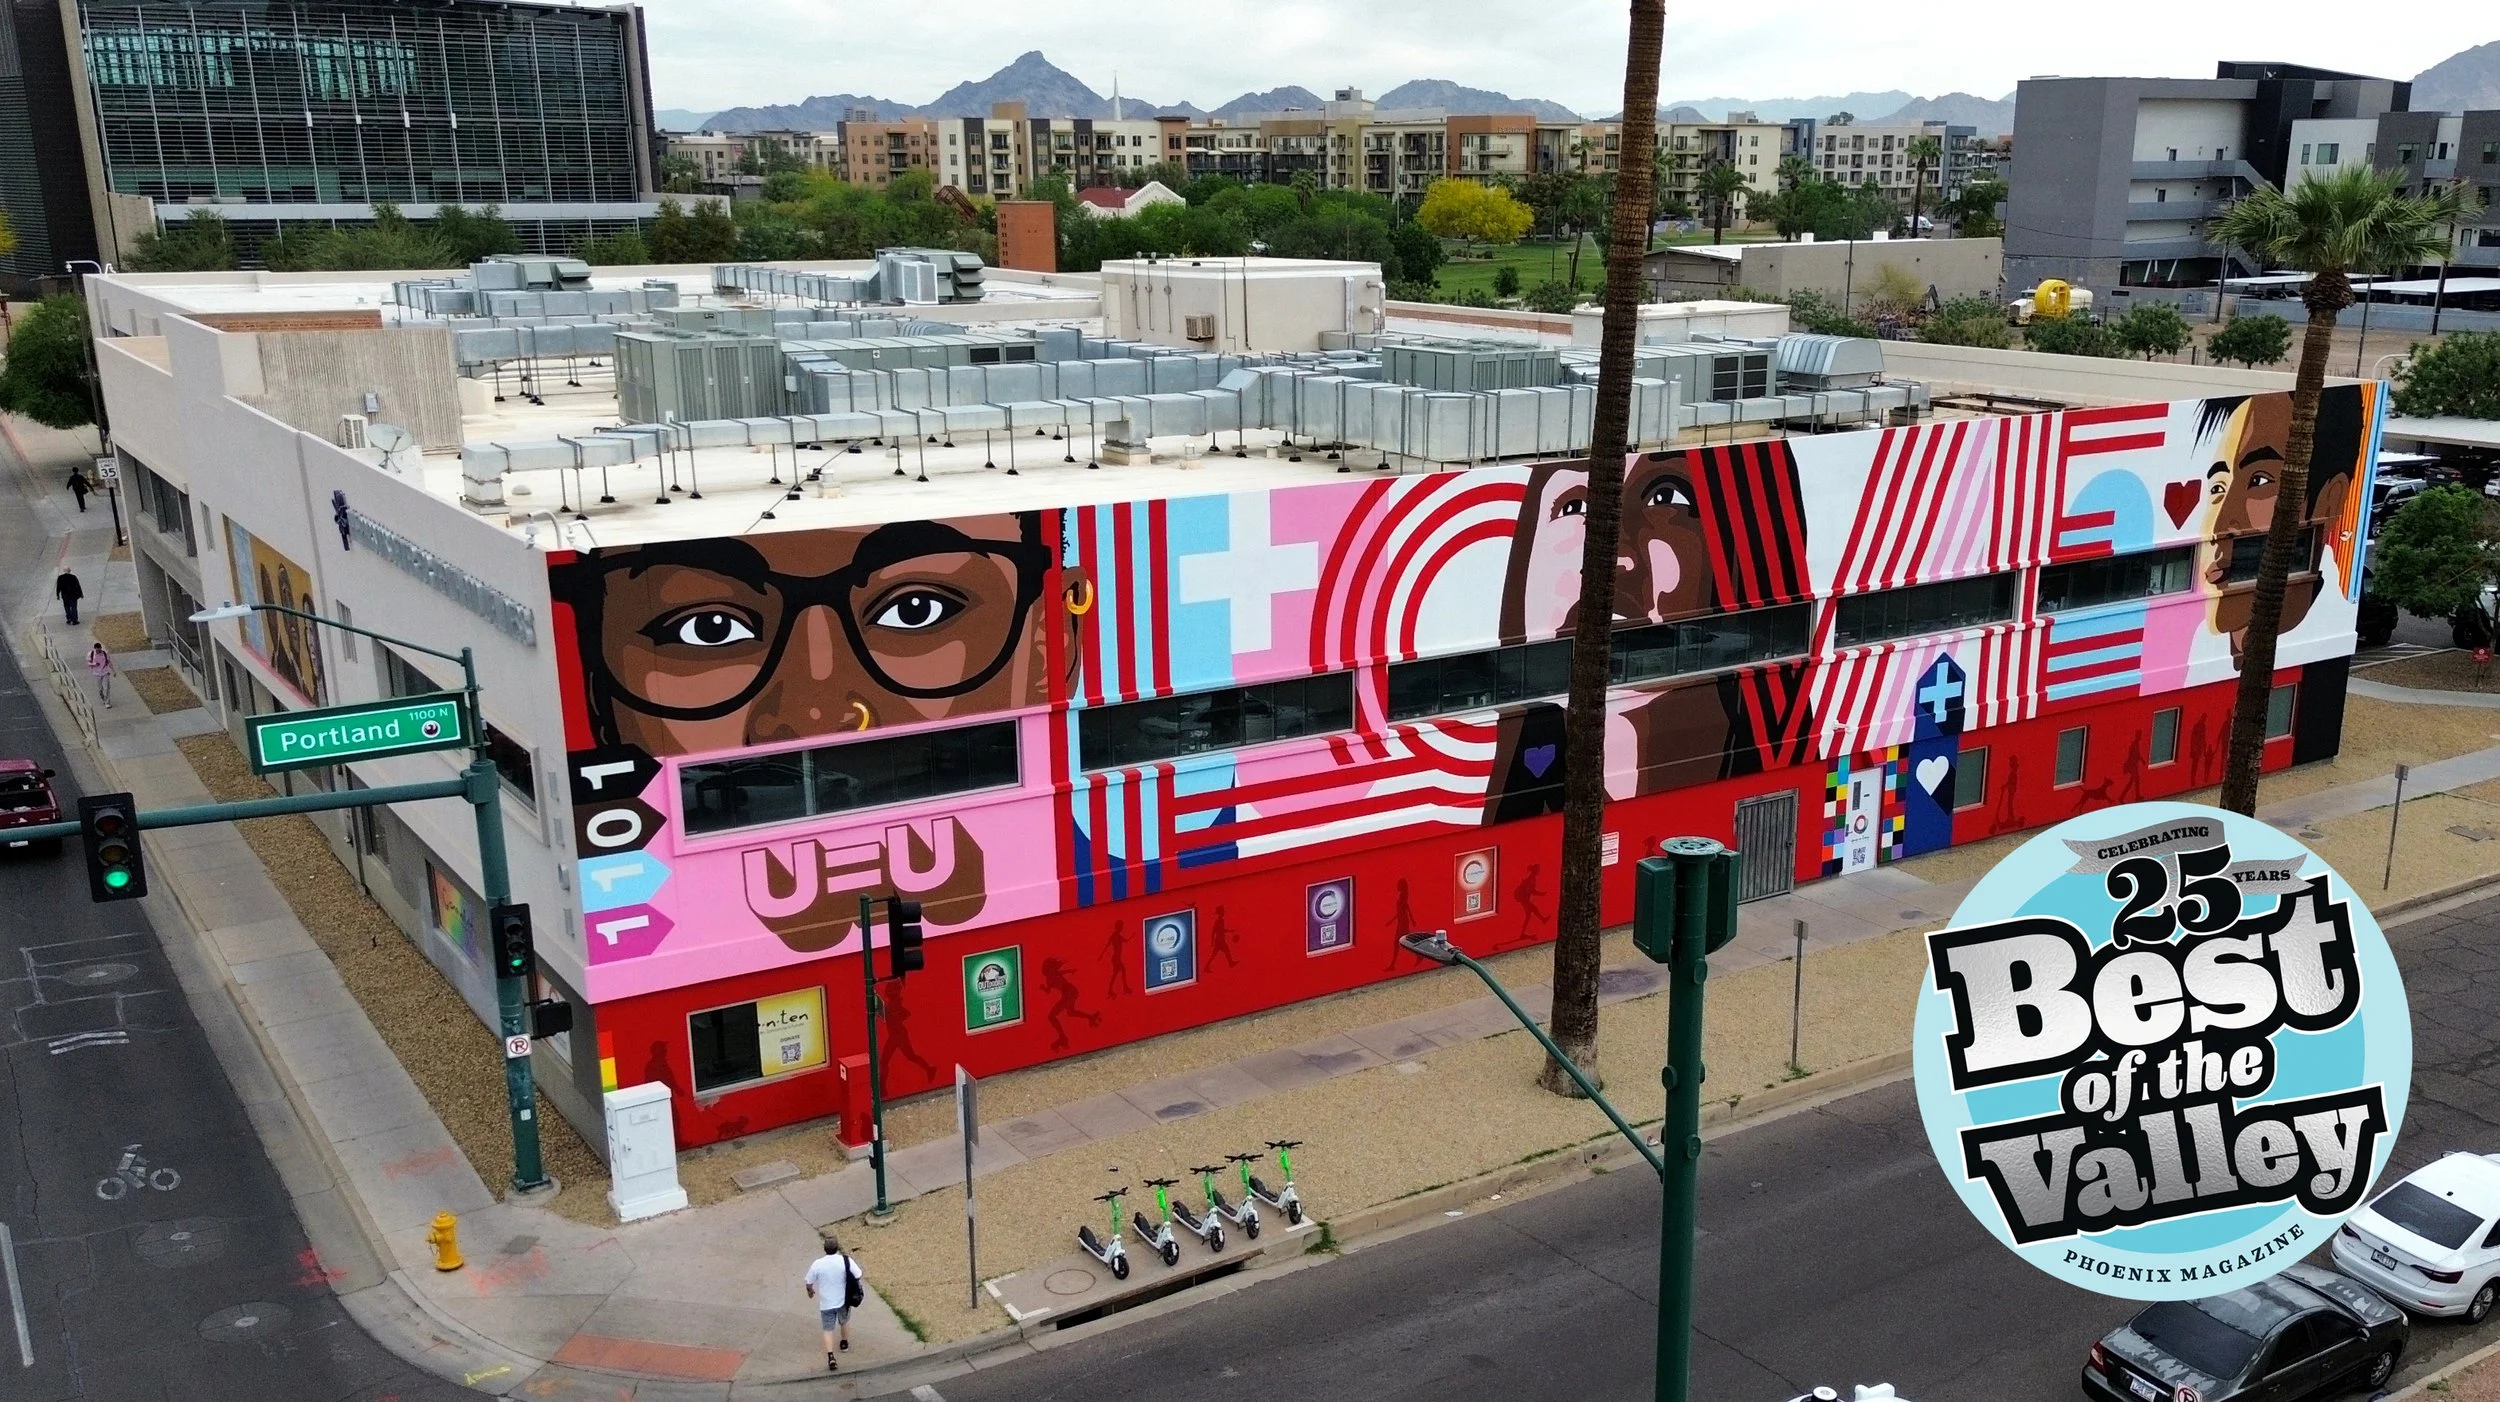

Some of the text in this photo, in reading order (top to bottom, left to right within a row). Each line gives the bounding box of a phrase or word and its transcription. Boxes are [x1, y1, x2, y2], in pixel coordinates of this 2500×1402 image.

[100, 468, 117, 478] 35
[408, 707, 449, 721] 1100 N
[280, 718, 400, 752] Portland
